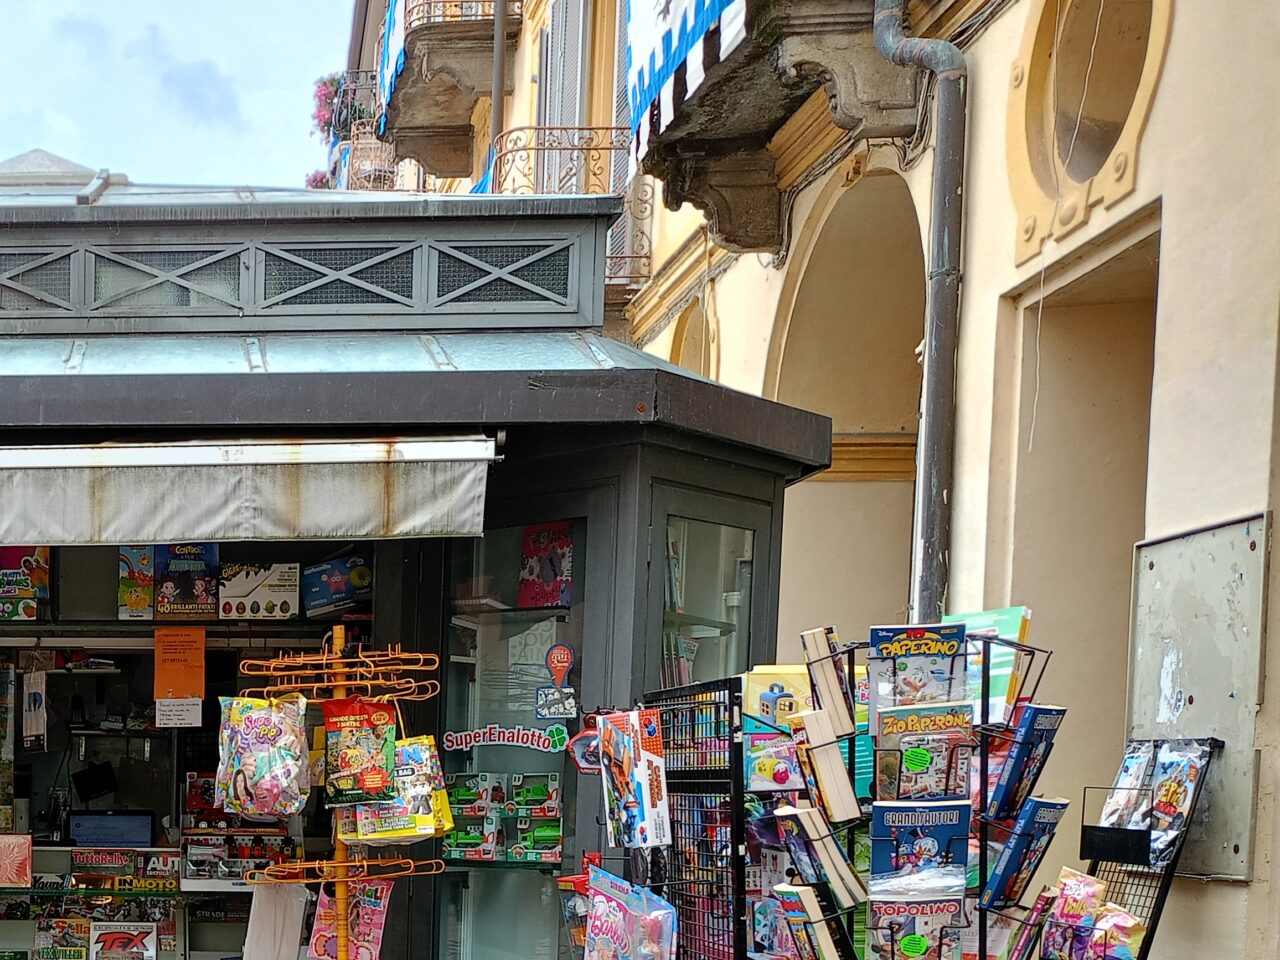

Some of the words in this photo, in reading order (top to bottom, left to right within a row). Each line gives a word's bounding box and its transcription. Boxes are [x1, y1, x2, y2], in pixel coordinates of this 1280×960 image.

[879, 640, 959, 657] PAPERINO
[444, 726, 551, 750] SuperEnalotto
[873, 902, 959, 917] TOPOLINO
[95, 931, 152, 951] TEX
